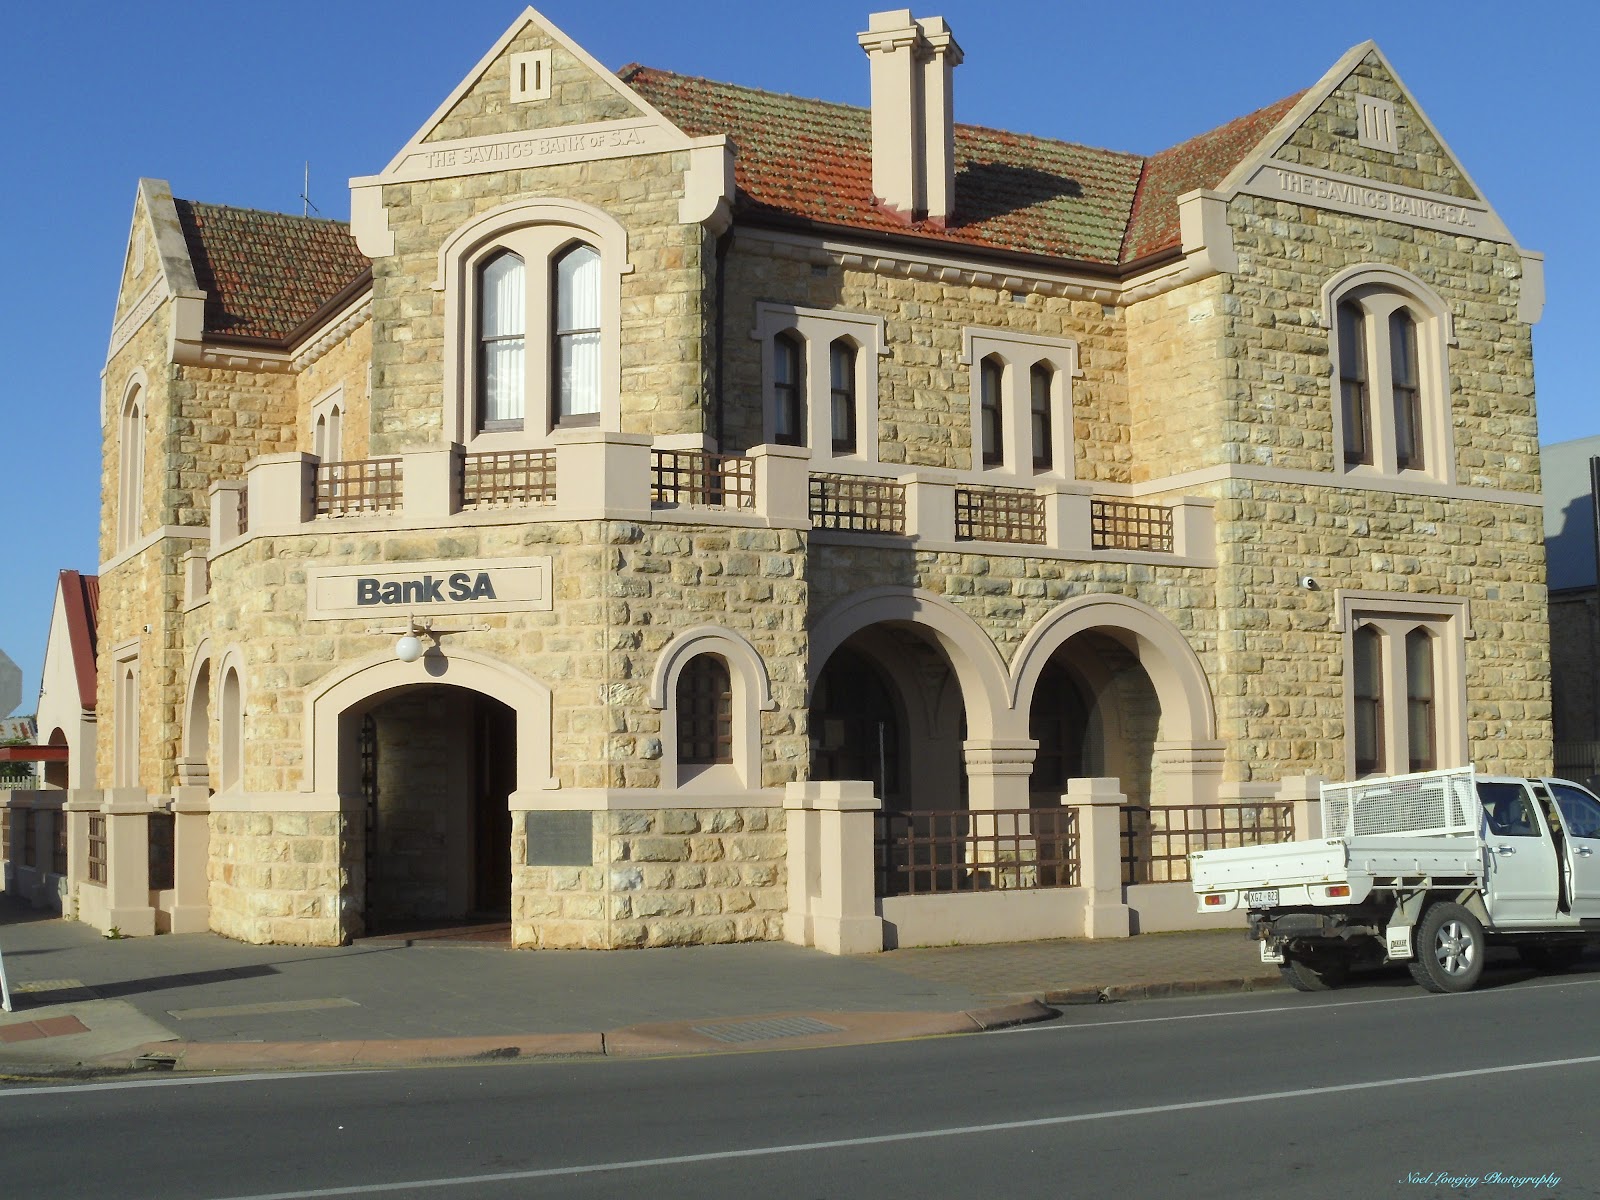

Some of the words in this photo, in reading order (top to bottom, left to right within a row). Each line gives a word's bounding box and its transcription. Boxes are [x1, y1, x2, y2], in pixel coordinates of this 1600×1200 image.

[424, 150, 456, 169] THE
[461, 140, 533, 165] SAVINGS
[537, 134, 585, 156] BANK
[589, 135, 605, 148] OF
[1277, 169, 1313, 195] THE
[1315, 177, 1388, 211] SAVINGS
[1390, 192, 1434, 220] BANK
[1433, 206, 1446, 219] OF
